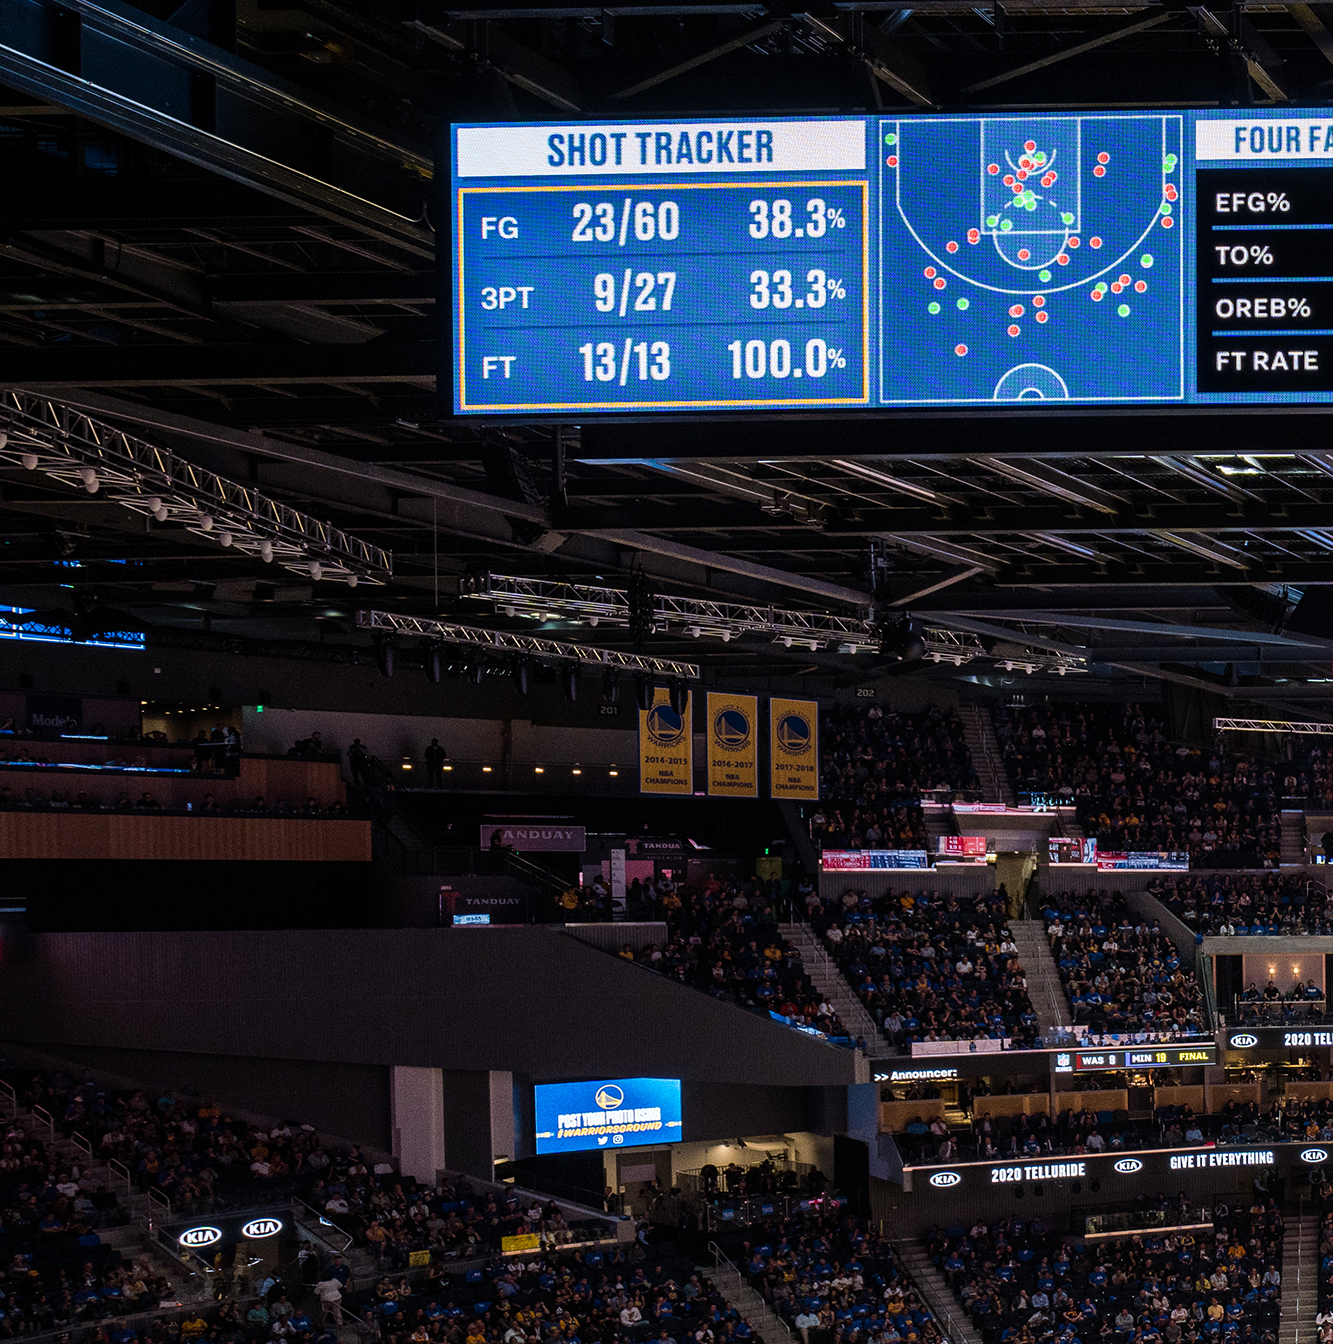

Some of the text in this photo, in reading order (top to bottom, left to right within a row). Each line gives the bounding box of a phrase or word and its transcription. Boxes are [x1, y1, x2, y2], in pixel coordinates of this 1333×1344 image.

[547, 130, 774, 169] SHOT TRACKER
[1234, 126, 1301, 154] FOUR
[1215, 192, 1290, 213] EFG%
[481, 200, 846, 244] FG 23/60 38.3%
[1215, 245, 1274, 266] TO%
[480, 269, 846, 315] 3PT 9/27 33.3%
[1215, 298, 1311, 319] OREB%
[482, 339, 846, 385] FT 13/13 100.0%
[1216, 352, 1247, 371] FT
[1253, 351, 1319, 371] RATE
[856, 689, 874, 697] 202
[645, 777, 688, 786] CHAMPIONS
[1284, 1033, 1312, 1045] 2020
[1170, 1150, 1274, 1170] GIVE IT EVERYTHING
[991, 1163, 1086, 1183] 2020 TELLURIDE
